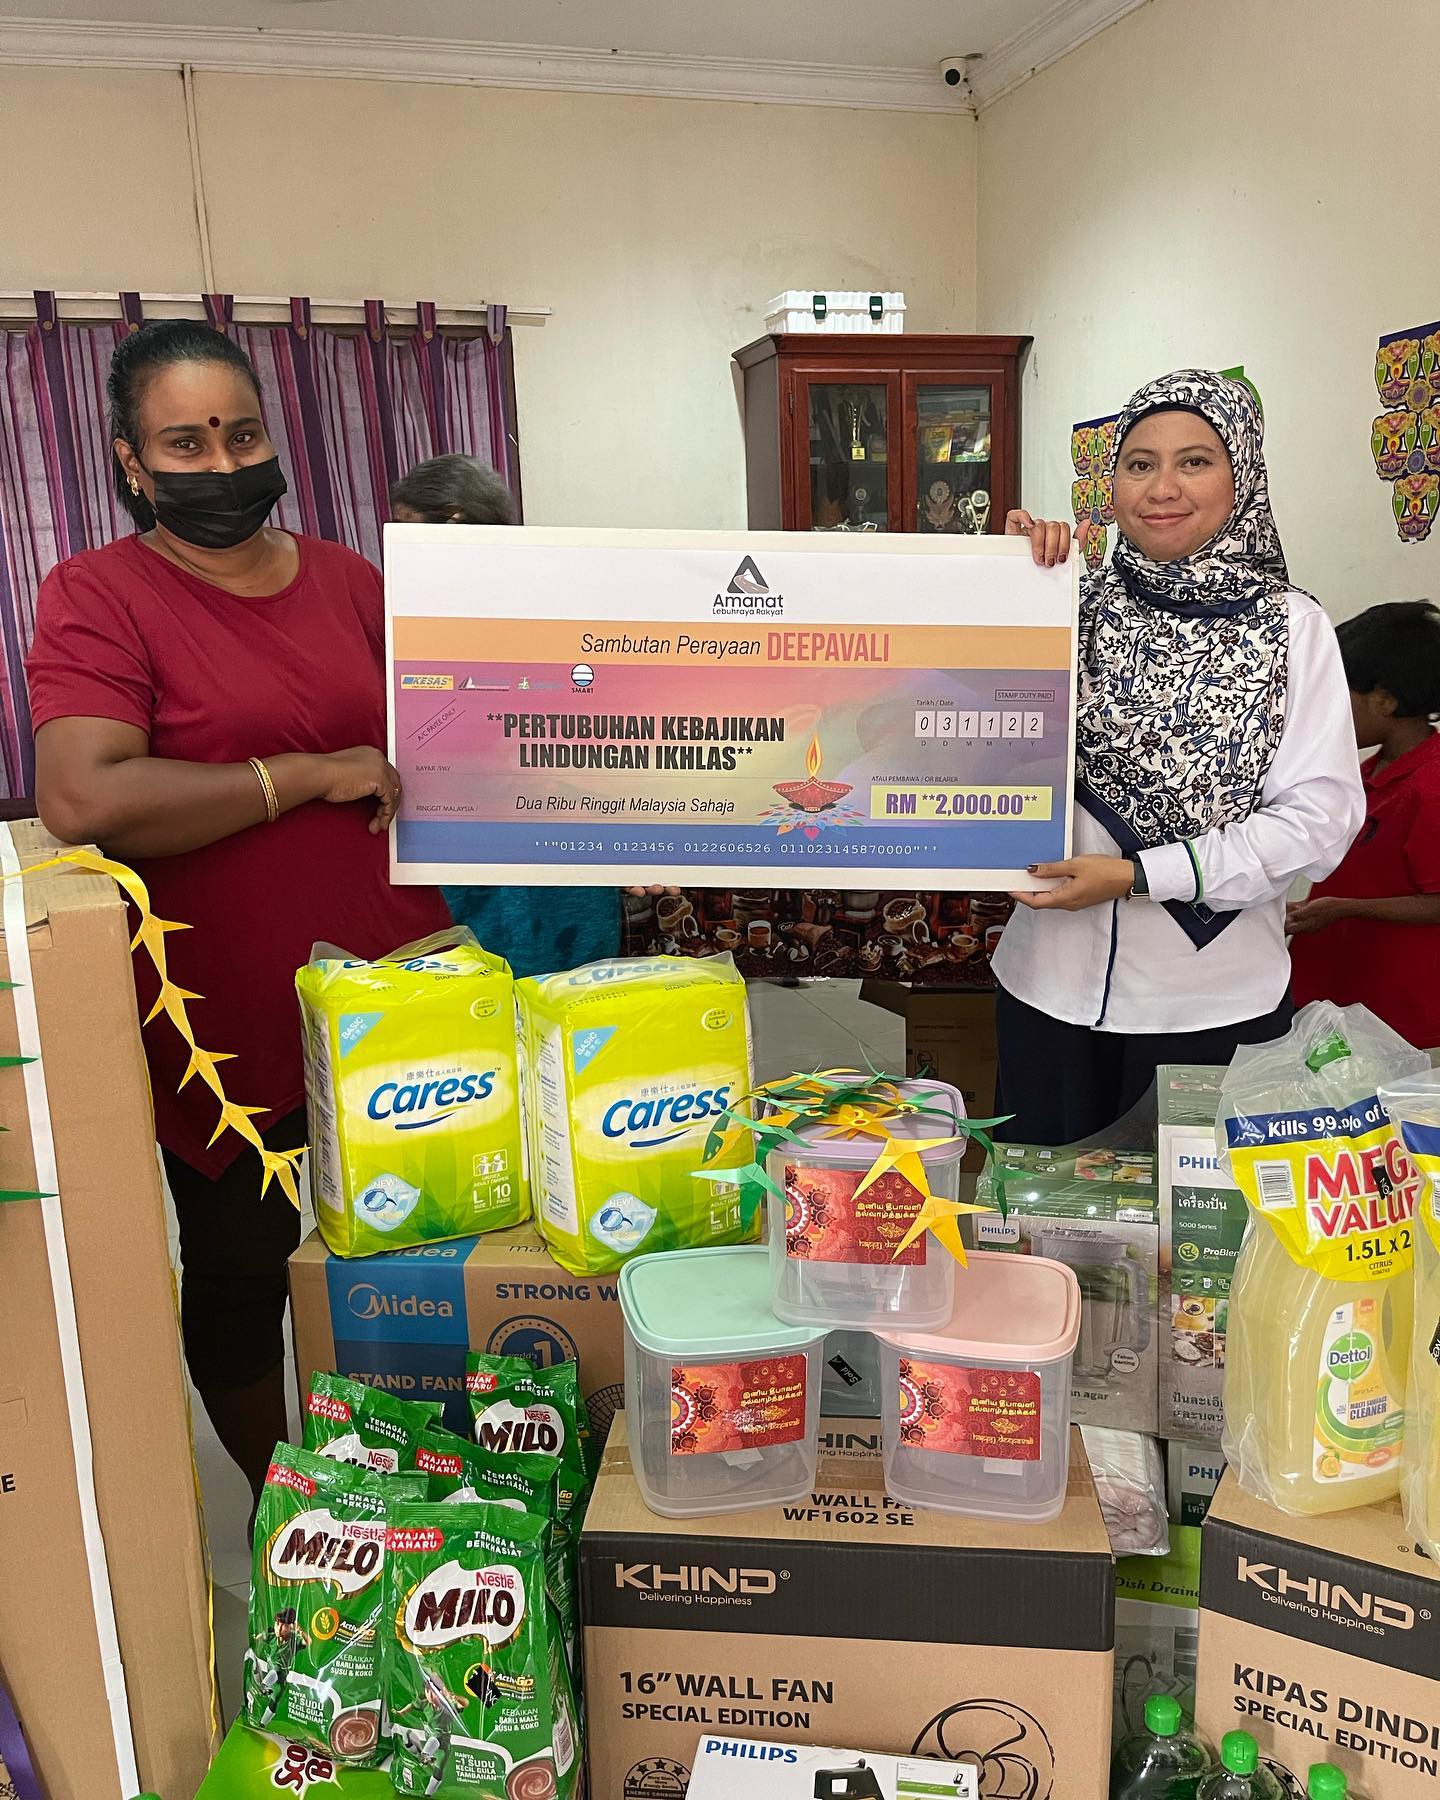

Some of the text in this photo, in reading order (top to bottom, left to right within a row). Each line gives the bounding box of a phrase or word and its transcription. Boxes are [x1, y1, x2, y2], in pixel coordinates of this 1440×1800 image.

[712, 593, 784, 610] Amanat
[712, 607, 784, 617] Lebuhraya Rakyat
[580, 631, 890, 662] Sambutan Perayaan DEEPAVALI
[412, 676, 448, 685] KESAS
[997, 692, 1052, 700] STAMP DUTY PAID
[660, 716, 785, 742] KEBAJIKAN
[919, 716, 1039, 732] 0 3 1 1 2 2
[519, 744, 649, 769] LINDUNGAN
[871, 775, 888, 783] ATAU
[889, 775, 919, 783] PEMBAWA
[515, 796, 735, 816] Dua Ribu Ringgit Malaysia Sahaja
[886, 793, 917, 814] RM
[613, 841, 674, 852] 0123456
[683, 842, 771, 854] 0122606526
[341, 1016, 364, 1040] BASIC
[367, 1071, 496, 1120] Caress
[602, 1085, 731, 1138] Caress
[1267, 1120, 1308, 1138] Kills
[1365, 1104, 1381, 1123] of
[1307, 1139, 1419, 1200] MEG
[473, 1190, 485, 1204] L
[493, 1183, 511, 1200] 10
[709, 1210, 721, 1225] L
[1178, 1221, 1218, 1231] 5000 Series
[981, 1226, 1016, 1237] PHILIPS
[1345, 1229, 1412, 1262] 1.5L x 2
[1368, 1259, 1393, 1271] CITRUS
[495, 1283, 591, 1301] STRONG
[350, 1289, 454, 1320] Midea
[1329, 1346, 1371, 1366] Dettol
[348, 1372, 463, 1392] STAND FAN
[313, 1394, 345, 1412] WAJAH
[1083, 1391, 1109, 1401] agar
[308, 1403, 347, 1420] BAHARU
[1349, 1403, 1388, 1420] CLEANER
[480, 1420, 558, 1453] MILO
[971, 1432, 996, 1445] happy
[418, 1459, 458, 1475] BAHARU
[422, 1452, 455, 1466] WAJAH
[276, 1467, 309, 1488] WAJAH
[486, 1469, 523, 1484] TENAGA
[272, 1475, 312, 1496] BAHARU
[481, 1474, 535, 1497] BERKHASIAT
[342, 1492, 386, 1506] TENAGA
[810, 1493, 877, 1509] WALL
[783, 1507, 914, 1526] WF1602 SE
[391, 1540, 438, 1550] BAHARU
[393, 1532, 436, 1541] WAJAH
[474, 1530, 507, 1548] TENAGA
[278, 1527, 380, 1577] MILO
[466, 1540, 523, 1558] BERKHASIAT
[615, 1562, 777, 1595] KHIND
[1115, 1575, 1146, 1591] Dish
[639, 1591, 752, 1606] Delivering Happiness
[1237, 1555, 1415, 1630] KHIND
[412, 1587, 516, 1633] MILO
[1261, 1590, 1386, 1636] Delivering Happiness
[335, 1660, 353, 1670] BARLI
[339, 1653, 375, 1663] KEBAIKAN
[330, 1667, 348, 1676] SUSU
[354, 1669, 373, 1677] KOKO
[288, 1689, 306, 1698] HANYA
[674, 1674, 764, 1701] WALL
[771, 1678, 834, 1704] FAN
[1232, 1662, 1328, 1713] KIPAS
[288, 1701, 325, 1718] KECIL GULA
[299, 1699, 325, 1711] SUDU
[501, 1707, 538, 1717] KEBAIKAN
[499, 1716, 518, 1724] BARLI
[622, 1702, 810, 1729] SPECIAL EDITION
[494, 1723, 513, 1732] SUSU
[520, 1722, 539, 1730] KOKO
[1233, 1695, 1438, 1777] SPECIAL EDITION
[455, 1751, 474, 1760] HANYA
[705, 1740, 798, 1764] PHILIPS
[455, 1764, 497, 1775] KECIL GULA
[467, 1759, 495, 1768] SUDU
